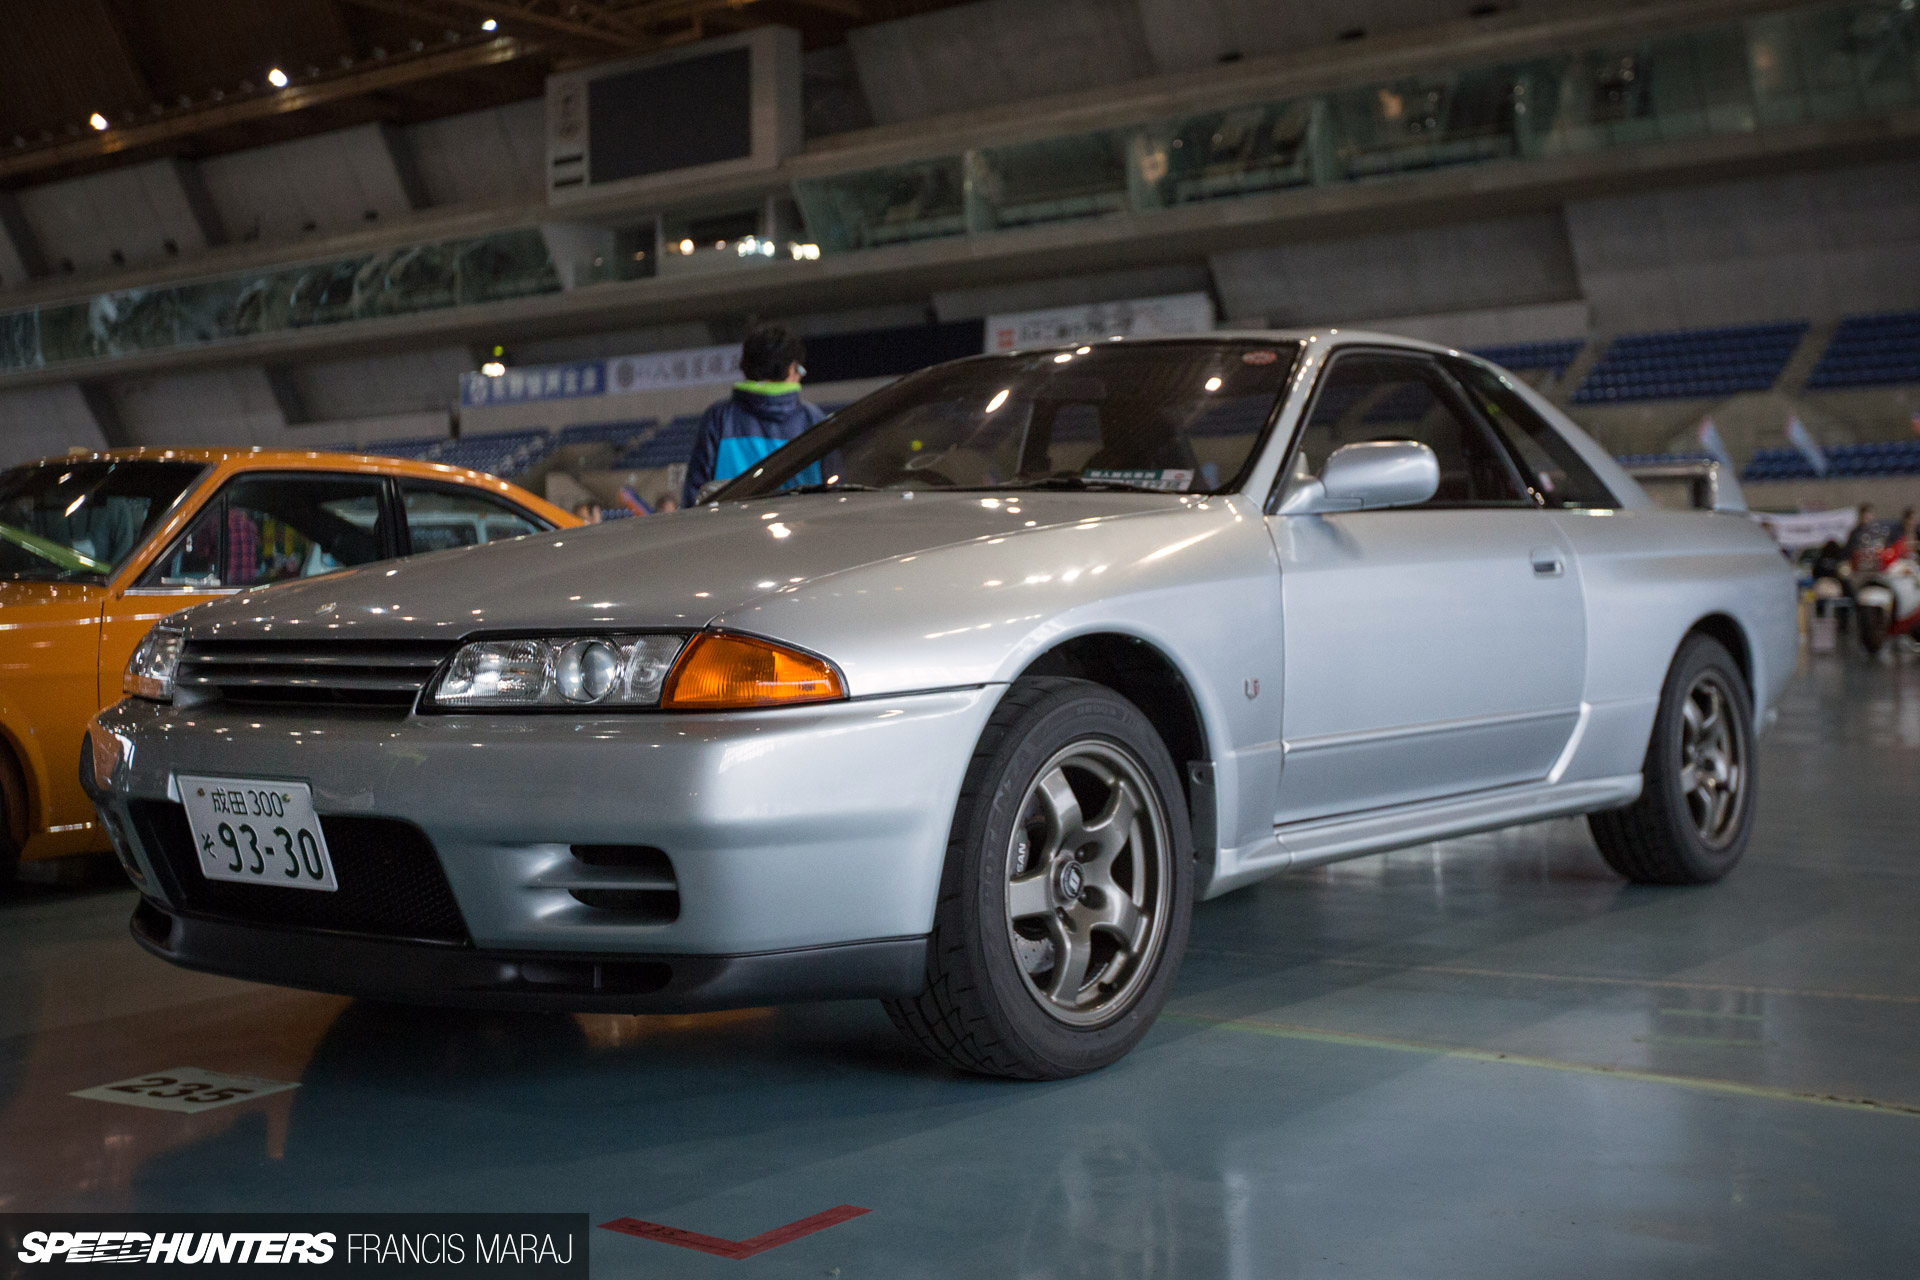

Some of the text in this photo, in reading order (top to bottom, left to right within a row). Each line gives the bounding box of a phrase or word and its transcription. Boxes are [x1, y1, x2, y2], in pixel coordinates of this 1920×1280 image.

[212, 788, 284, 817] 成田 300
[218, 822, 324, 880] 93-30
[106, 1076, 255, 1103] 235
